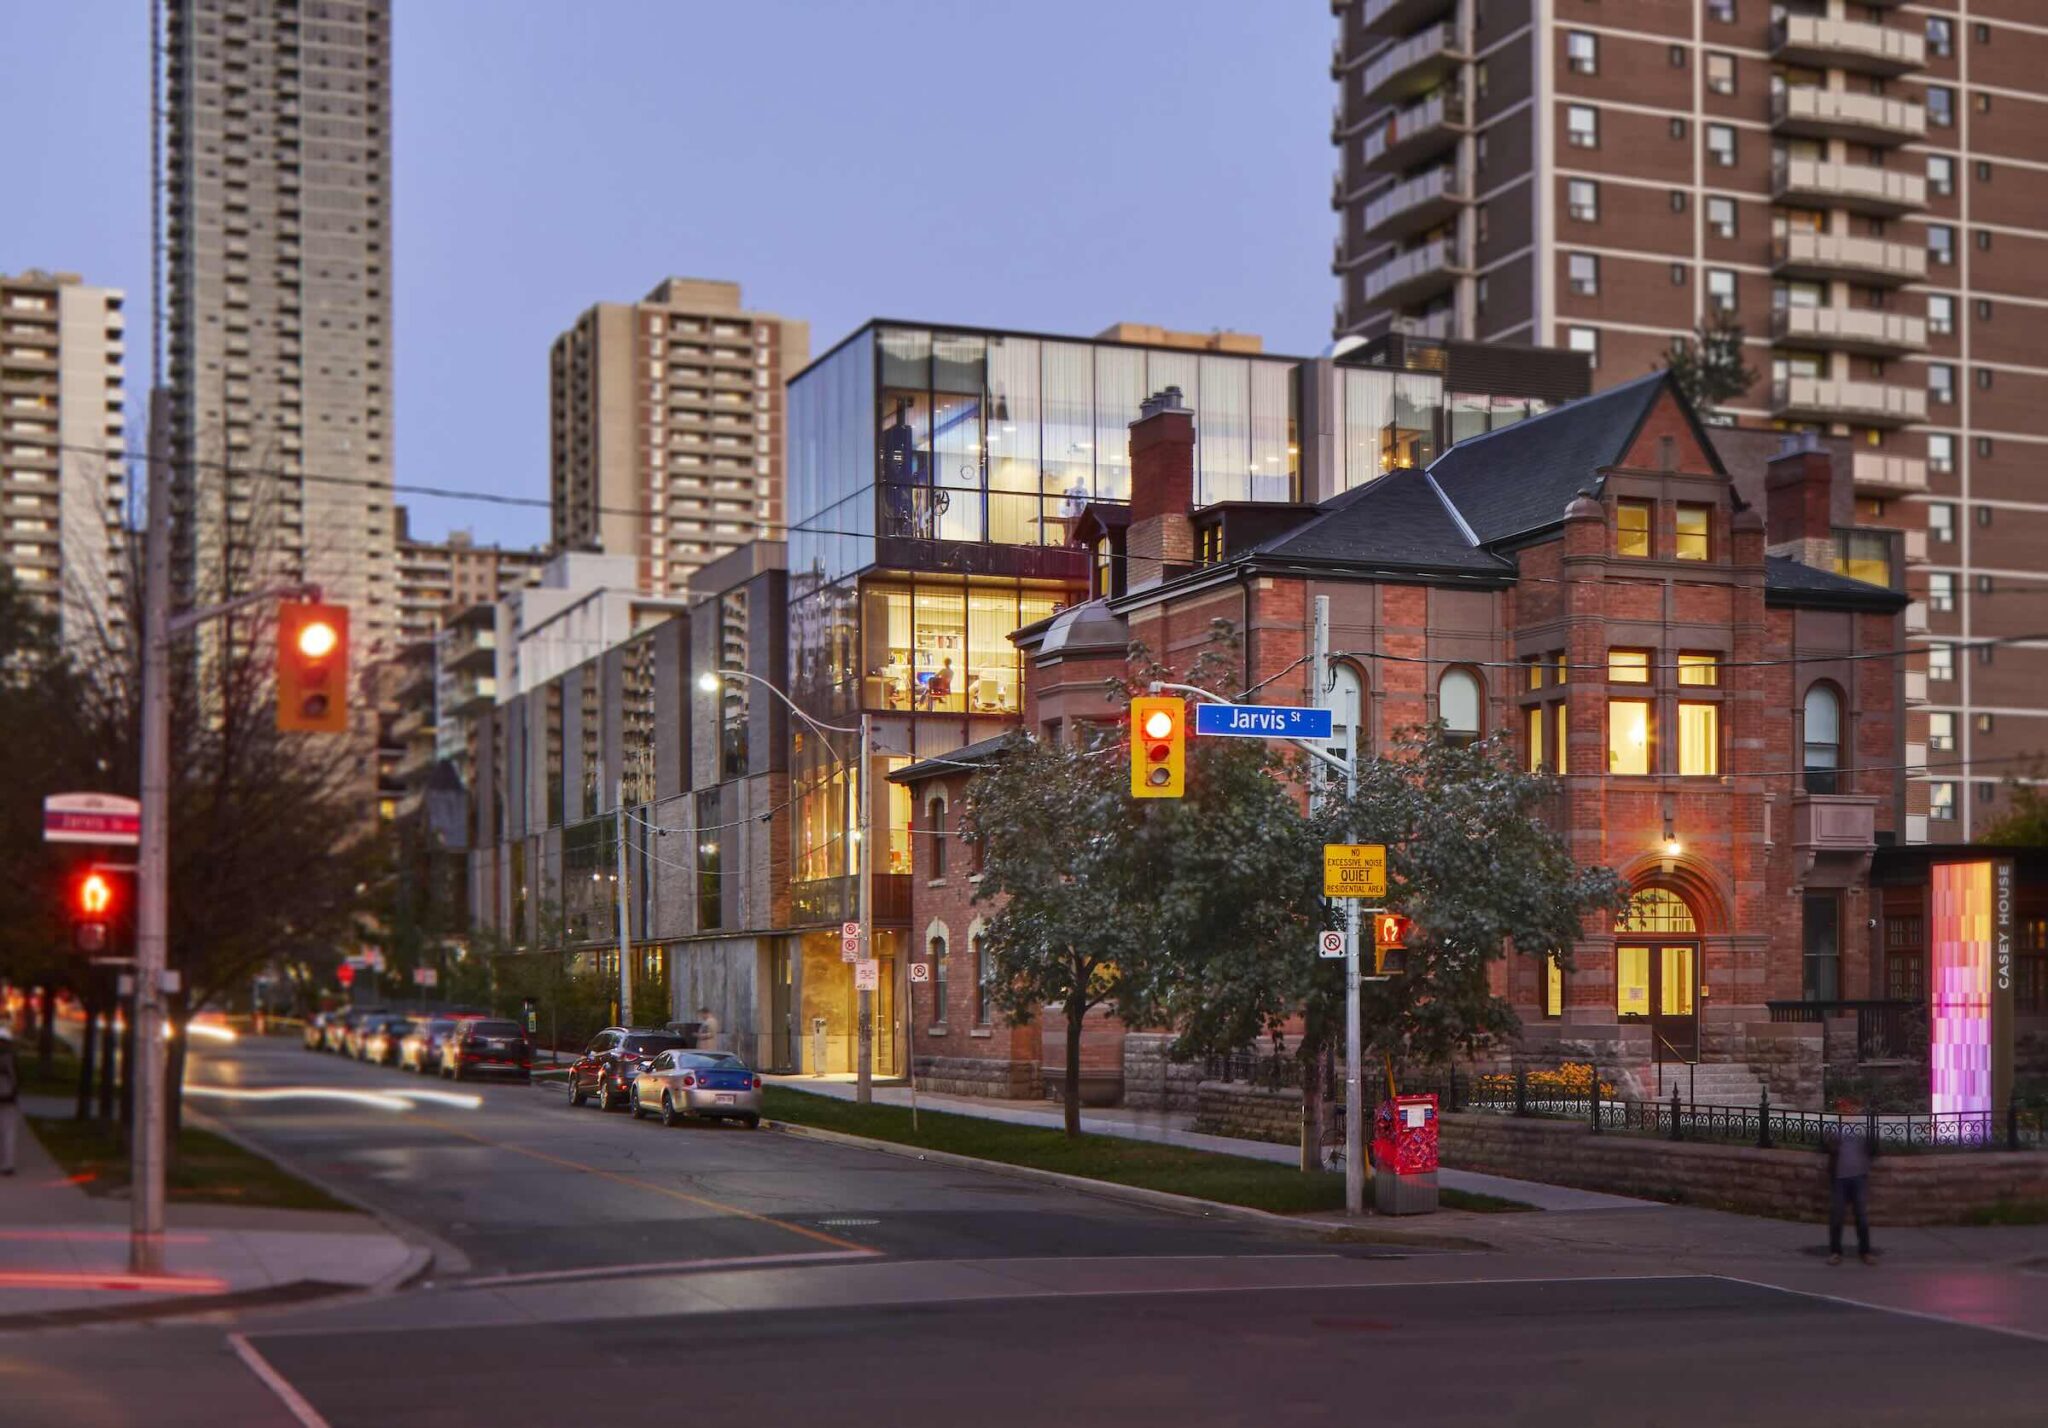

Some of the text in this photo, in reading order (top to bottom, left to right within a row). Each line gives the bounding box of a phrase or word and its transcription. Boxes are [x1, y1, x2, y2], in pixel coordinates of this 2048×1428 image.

[1229, 709, 1300, 729] Jarvis St
[1352, 849, 1360, 857] NO
[1327, 858, 1383, 867] EXCESSIVE NOISE
[1341, 869, 1370, 882] QUIET
[1326, 885, 1383, 893] RESIDENTIAL AREA
[1998, 865, 2009, 989] CASEY HOUSE
